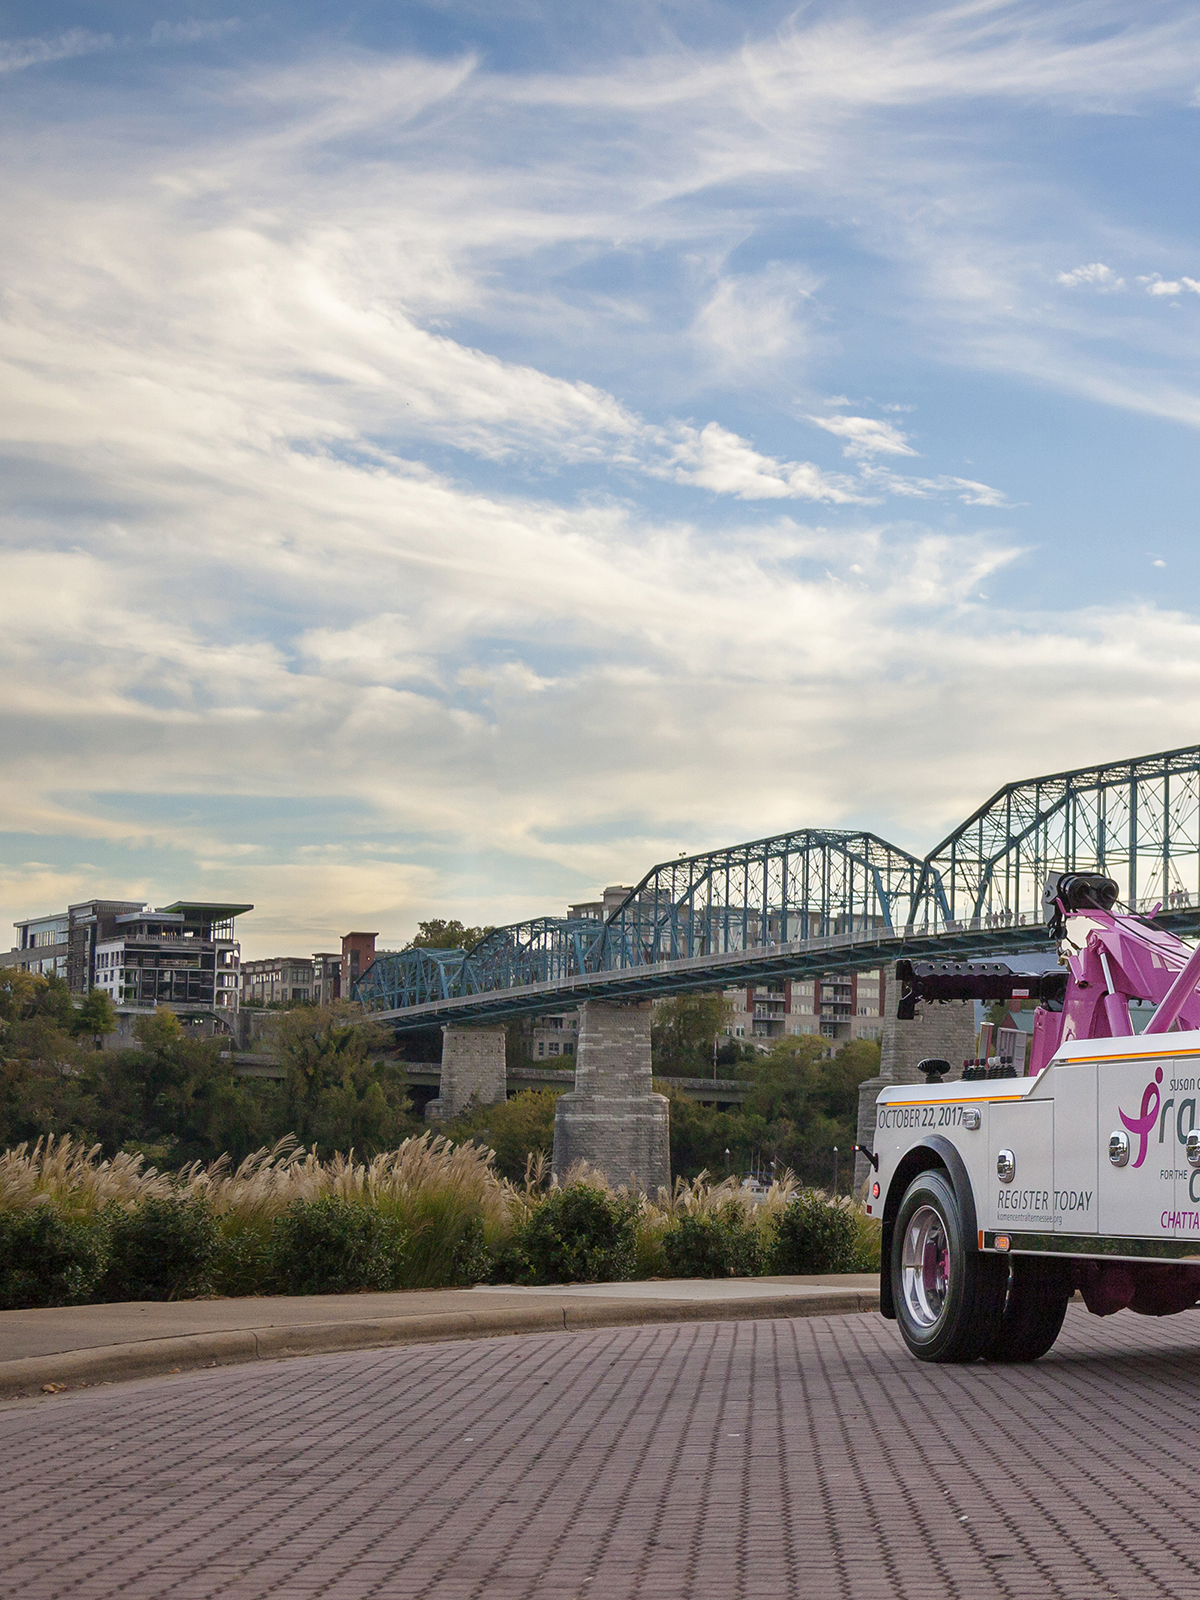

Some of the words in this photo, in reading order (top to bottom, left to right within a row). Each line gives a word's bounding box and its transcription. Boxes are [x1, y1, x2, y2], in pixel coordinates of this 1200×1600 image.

[878, 1108, 920, 1129] OCTOBER
[921, 1107, 937, 1129] 22,
[938, 1106, 963, 1126] 2017
[1160, 1169, 1174, 1179] FOR
[1174, 1169, 1188, 1180] THE
[997, 1190, 1049, 1210] REGISTER
[1053, 1191, 1093, 1211] TODAY
